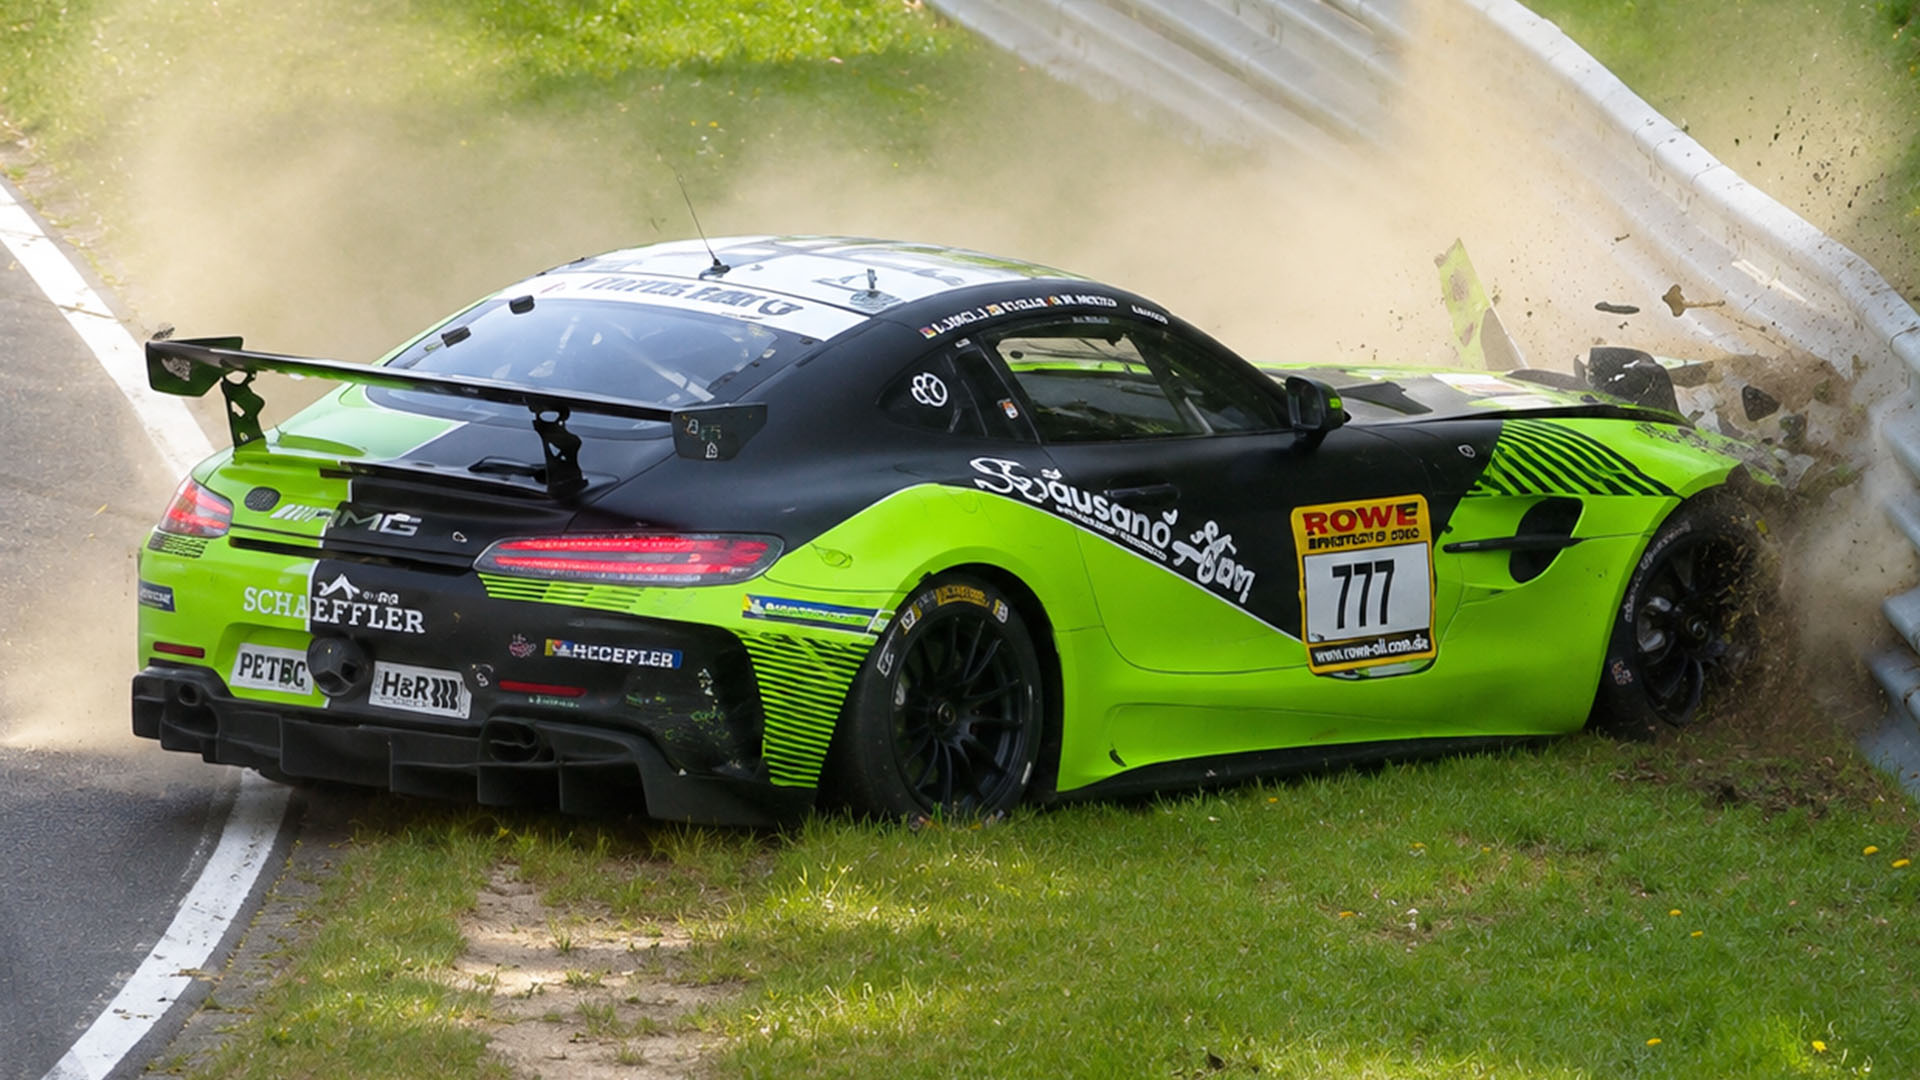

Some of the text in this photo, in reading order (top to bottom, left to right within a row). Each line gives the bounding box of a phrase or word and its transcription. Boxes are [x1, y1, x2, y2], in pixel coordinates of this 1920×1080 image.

[304, 505, 422, 536] AMG
[1303, 502, 1418, 534] ROWE
[243, 586, 425, 634] SCHAEFFLER
[1332, 559, 1395, 630] 777
